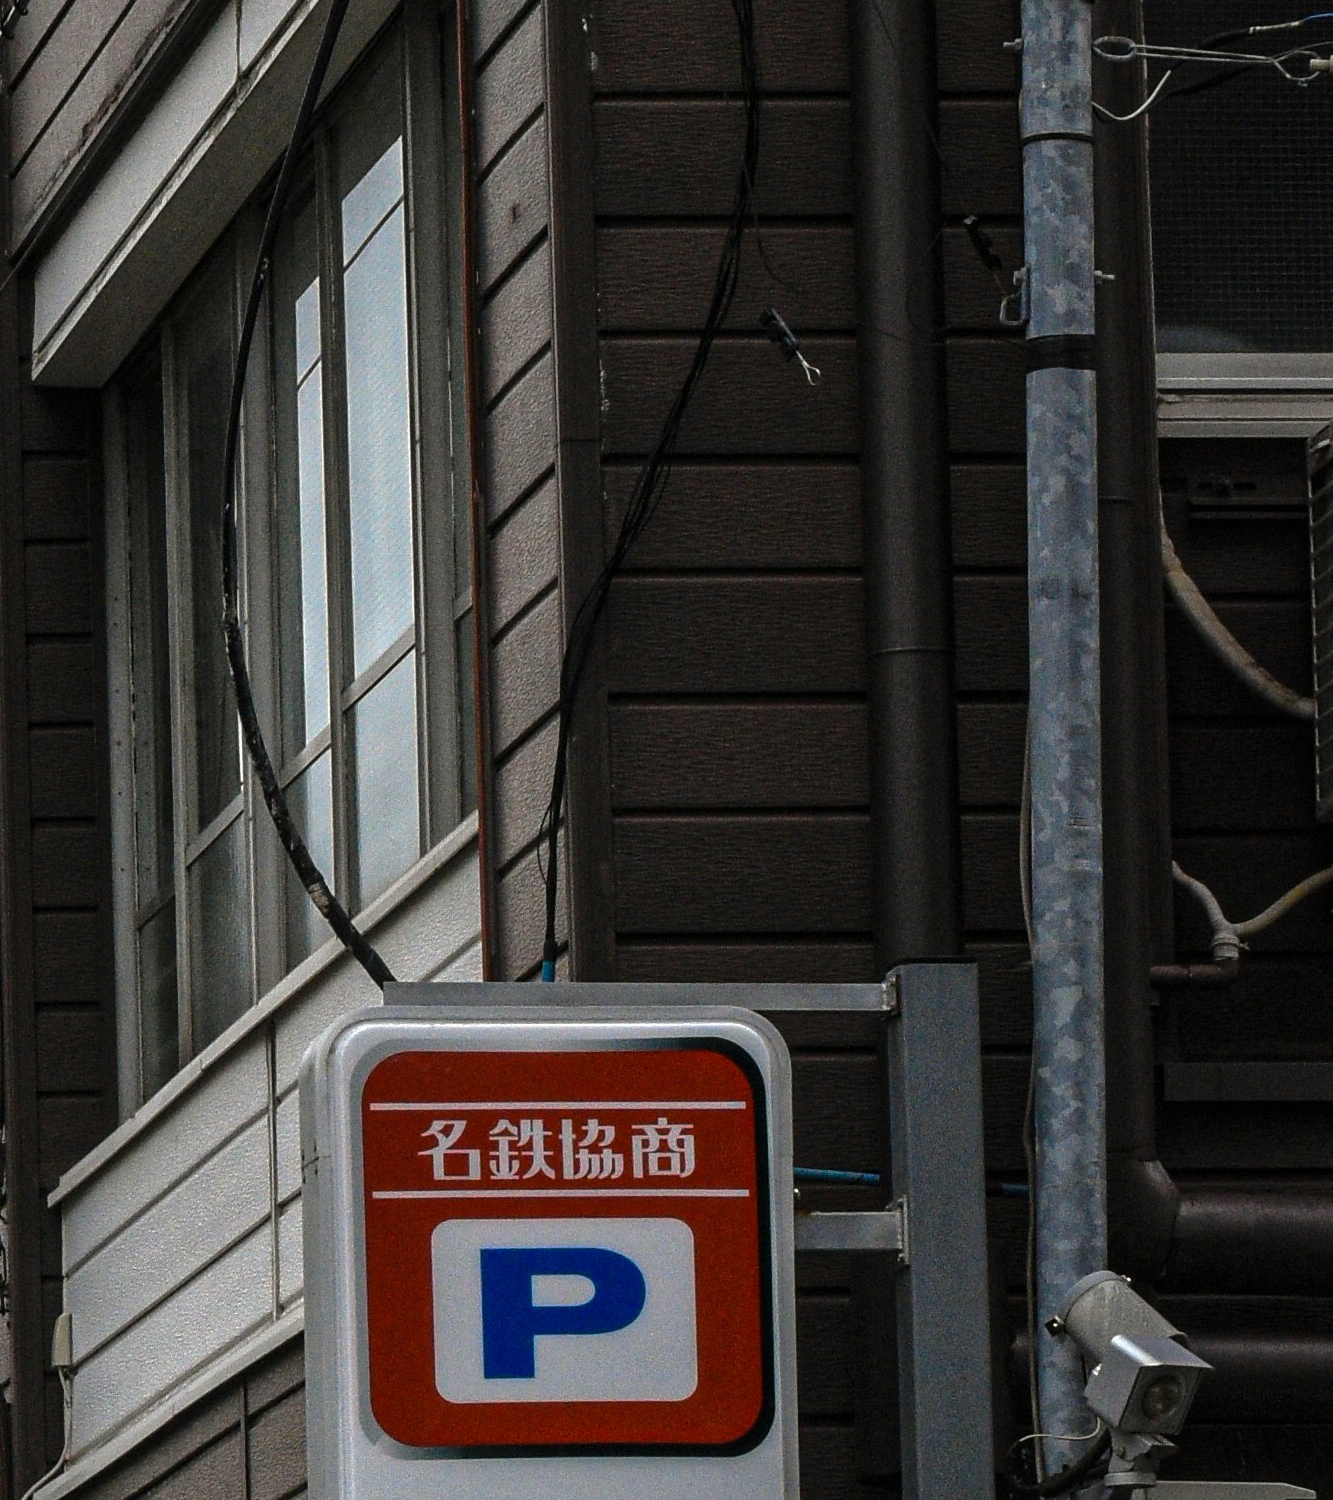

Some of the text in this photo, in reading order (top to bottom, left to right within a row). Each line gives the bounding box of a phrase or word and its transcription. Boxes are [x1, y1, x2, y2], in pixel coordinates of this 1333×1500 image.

[418, 1117, 697, 1183] 名鉄協商
[479, 1246, 648, 1382] P
